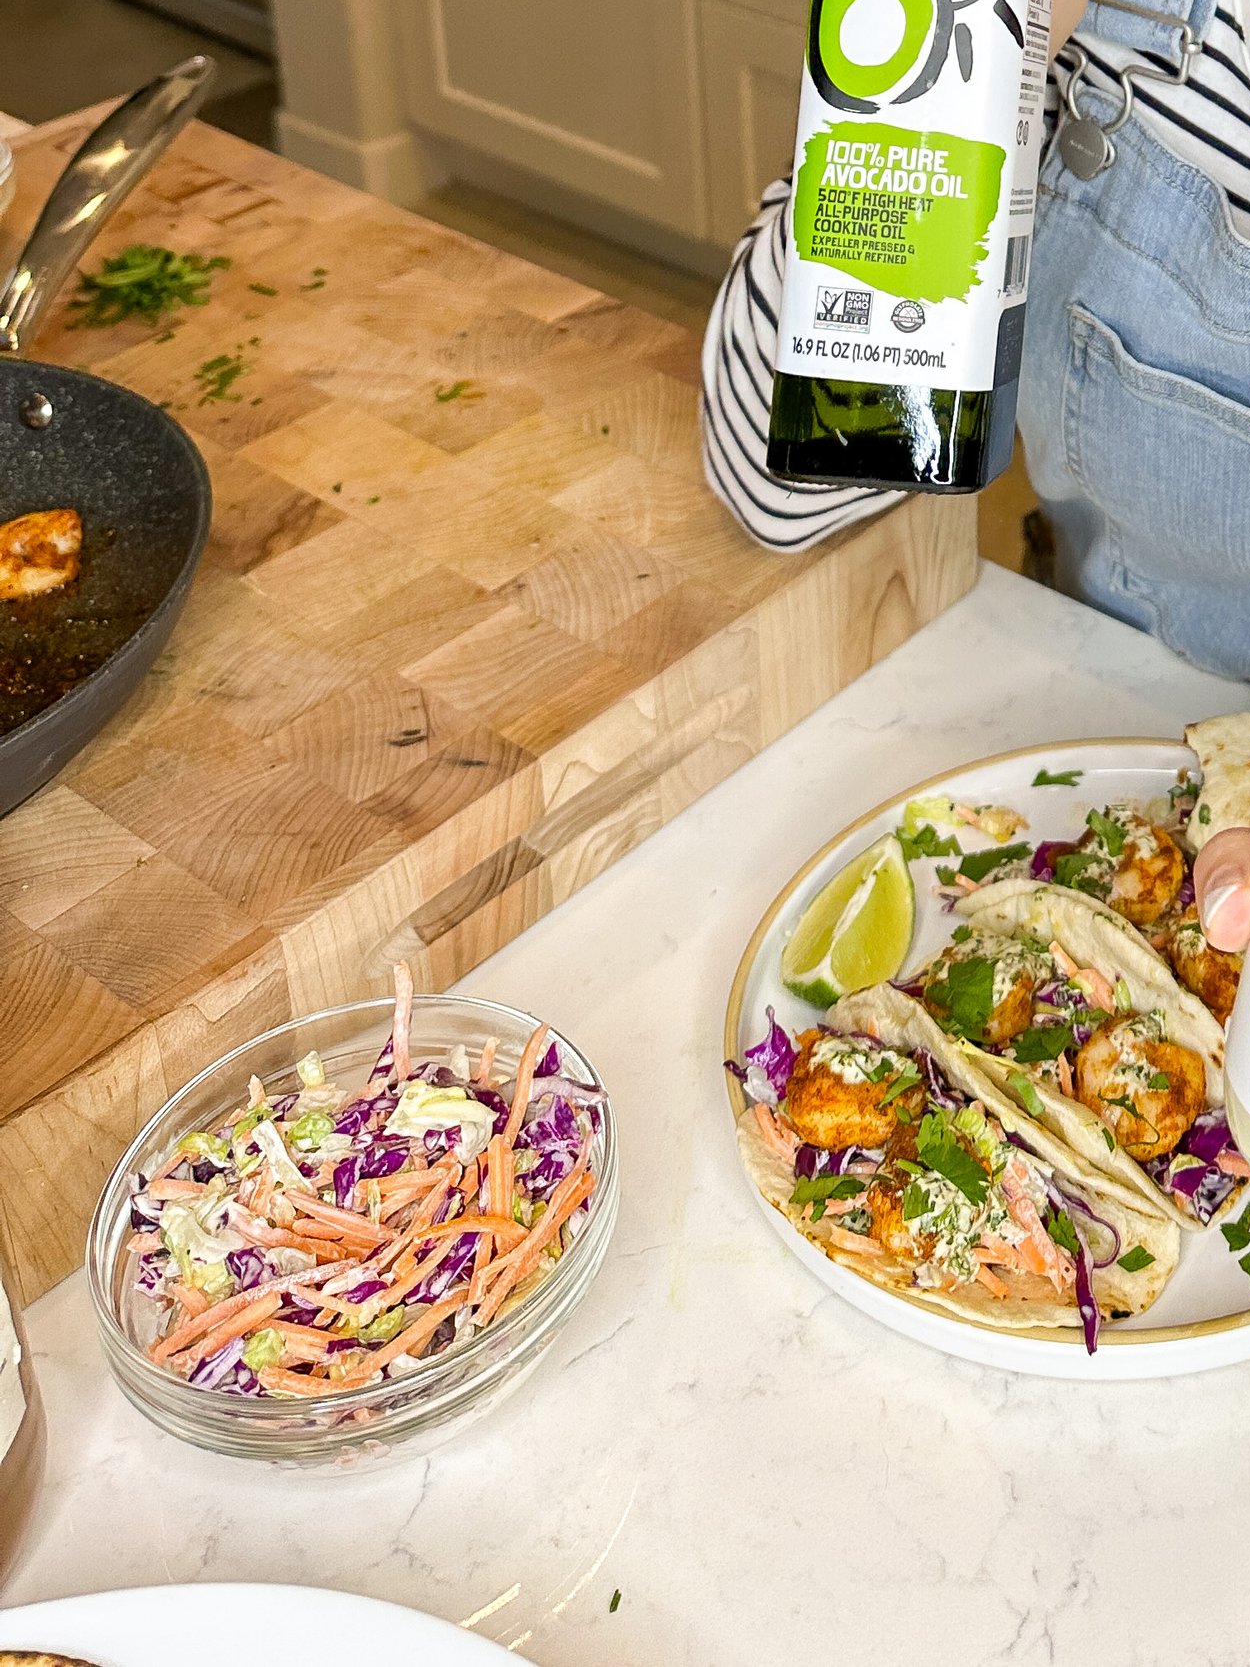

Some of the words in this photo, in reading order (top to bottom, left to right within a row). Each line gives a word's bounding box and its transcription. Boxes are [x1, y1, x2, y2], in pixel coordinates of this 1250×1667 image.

[825, 139, 885, 168] 100%
[887, 145, 949, 173] PURE
[821, 164, 929, 195] AVOCADO
[930, 174, 969, 199] OIL
[862, 193, 898, 209] HIGH
[899, 195, 934, 213] HEAT
[815, 203, 908, 225] ALL-PURPOSE
[813, 218, 877, 238] COOKING
[880, 224, 906, 240] OIL
[812, 235, 859, 250] EXPELLER
[861, 239, 906, 253] PRESSED
[907, 244, 915, 254] &
[810, 247, 862, 262] NATURALLY
[864, 251, 907, 265] REFINED
[846, 301, 869, 310] GMO
[847, 293, 870, 302] NON
[819, 313, 867, 324] VERIFIED
[792, 336, 813, 355] 16.9
[816, 340, 829, 357] FL
[831, 342, 850, 359] OZ
[852, 343, 880, 363] (1.06
[882, 346, 901, 367] PT)
[903, 348, 947, 369] 500mL
